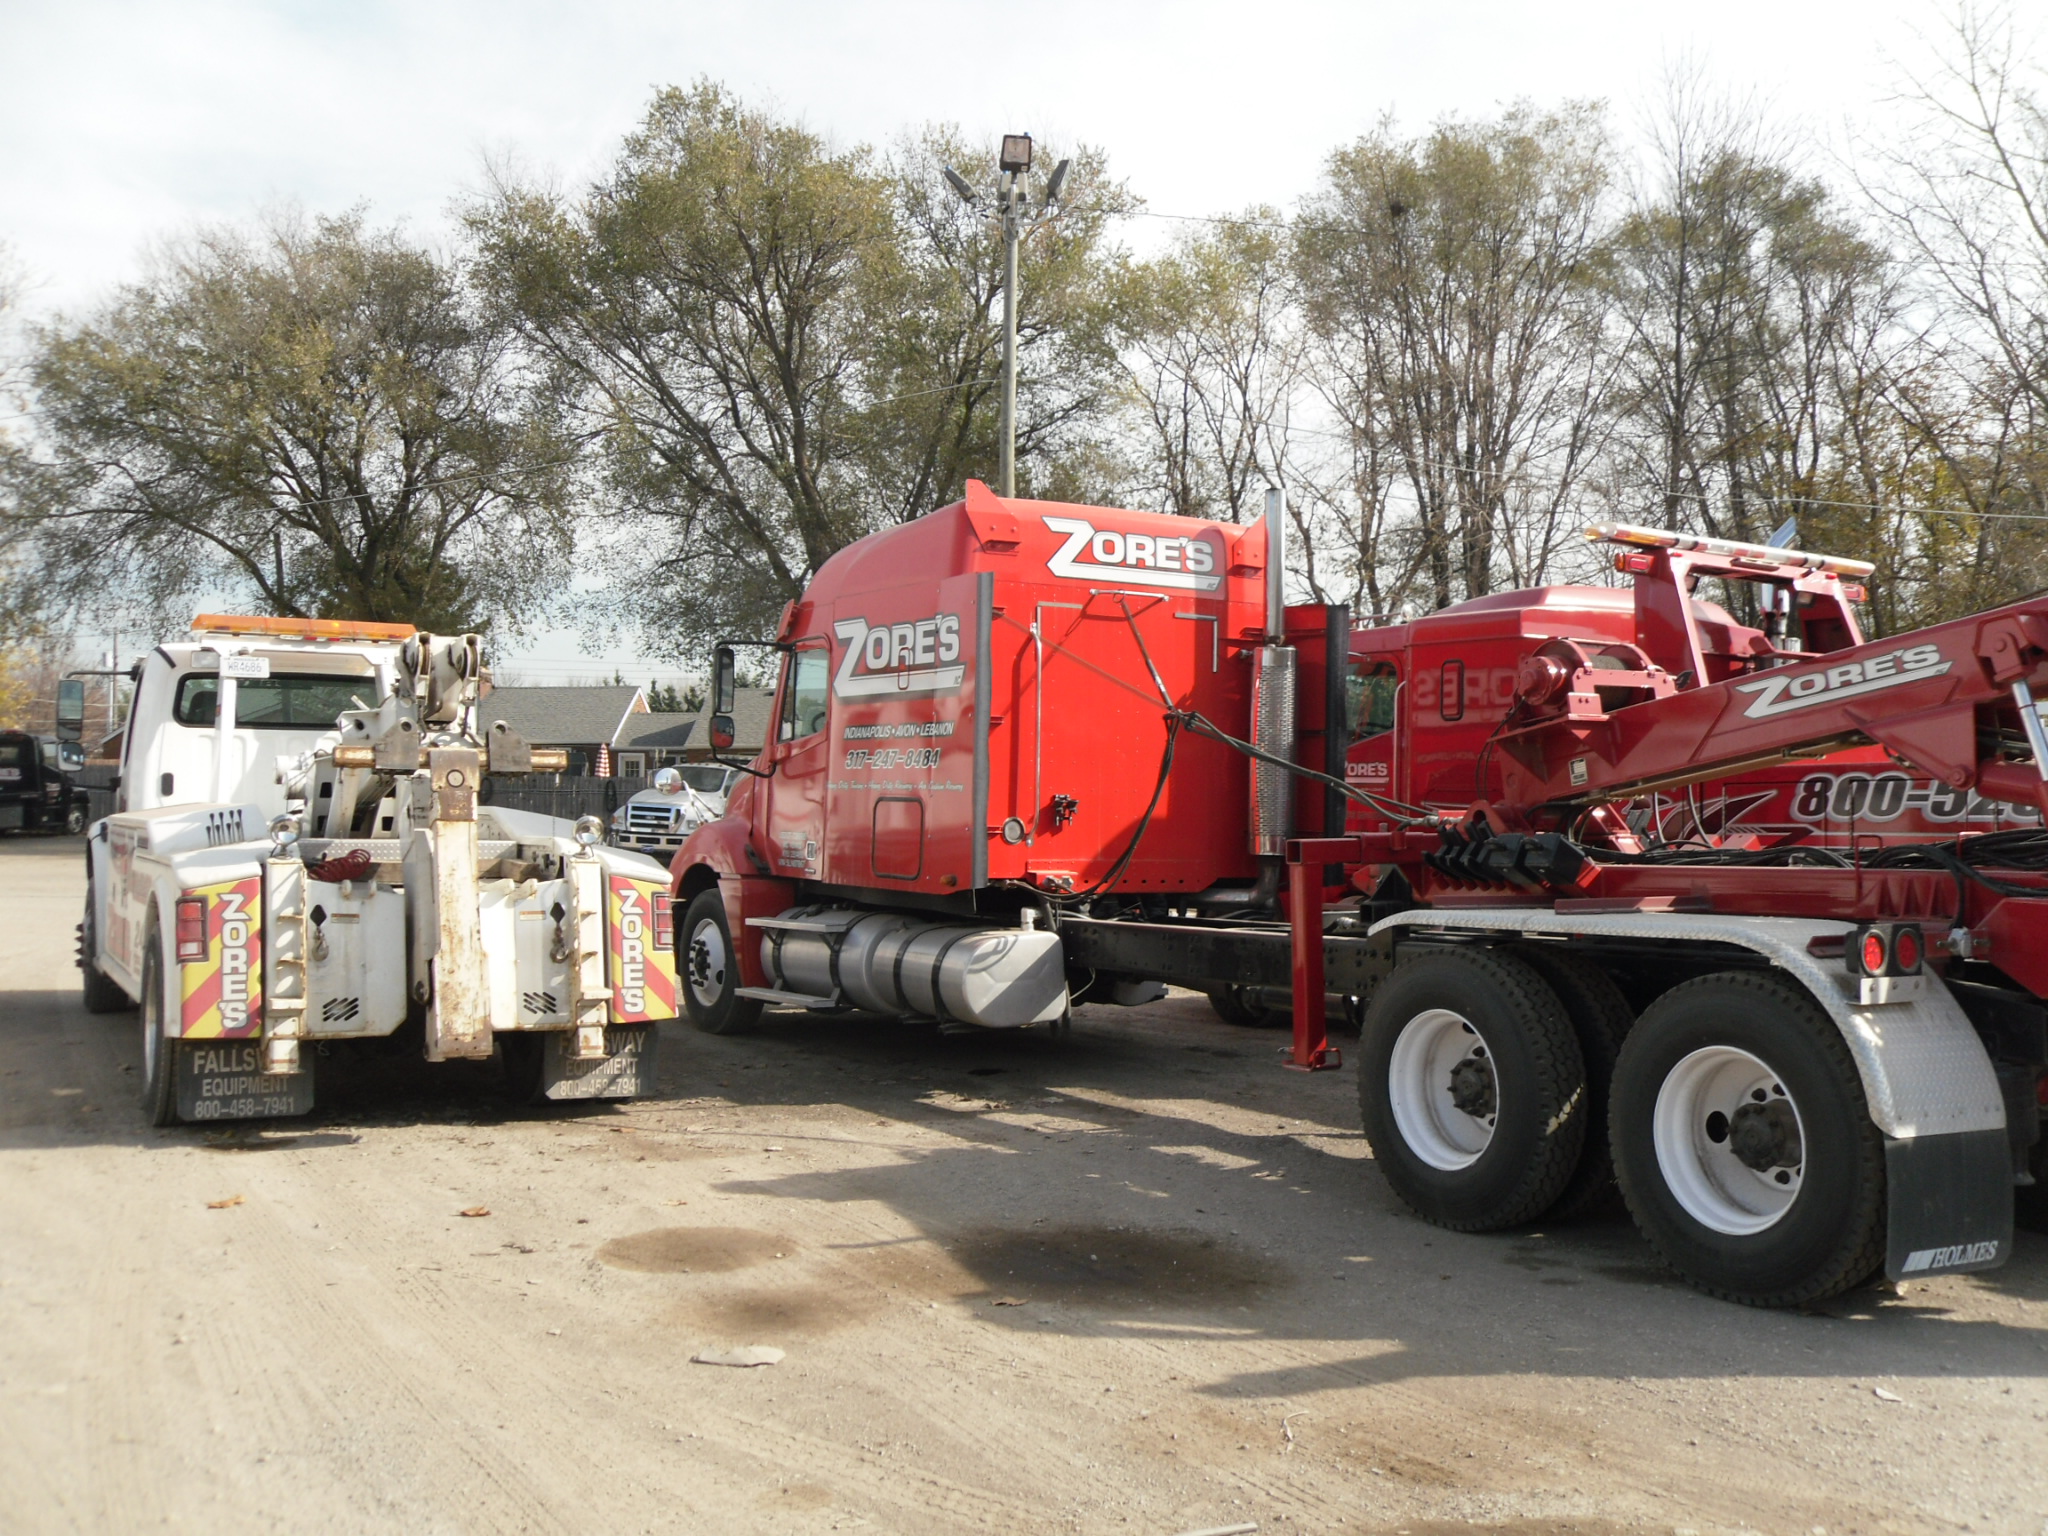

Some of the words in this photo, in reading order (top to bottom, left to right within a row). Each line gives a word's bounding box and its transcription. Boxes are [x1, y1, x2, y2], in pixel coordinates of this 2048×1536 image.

[1041, 516, 1222, 590] ZORE'S
[833, 614, 964, 697] ZORE'S
[1735, 644, 1953, 718] ZORE'S
[844, 725, 892, 739] INDIANAPOLIS
[895, 723, 915, 737] AVON
[920, 721, 955, 736] LEBANON
[845, 748, 942, 769] 317-247-8484
[1345, 761, 1389, 783] ORE'S
[218, 893, 252, 1029] ZORE'S
[619, 889, 646, 1014] ZORE'S
[193, 1047, 264, 1074] FALLS
[566, 1058, 638, 1076] EQUIPMENT
[202, 1075, 289, 1097] EQUIPMENT
[560, 1078, 641, 1097] 800-458-7941
[195, 1097, 294, 1119] 800-458-7941
[1931, 1240, 1998, 1268] HOLMES
